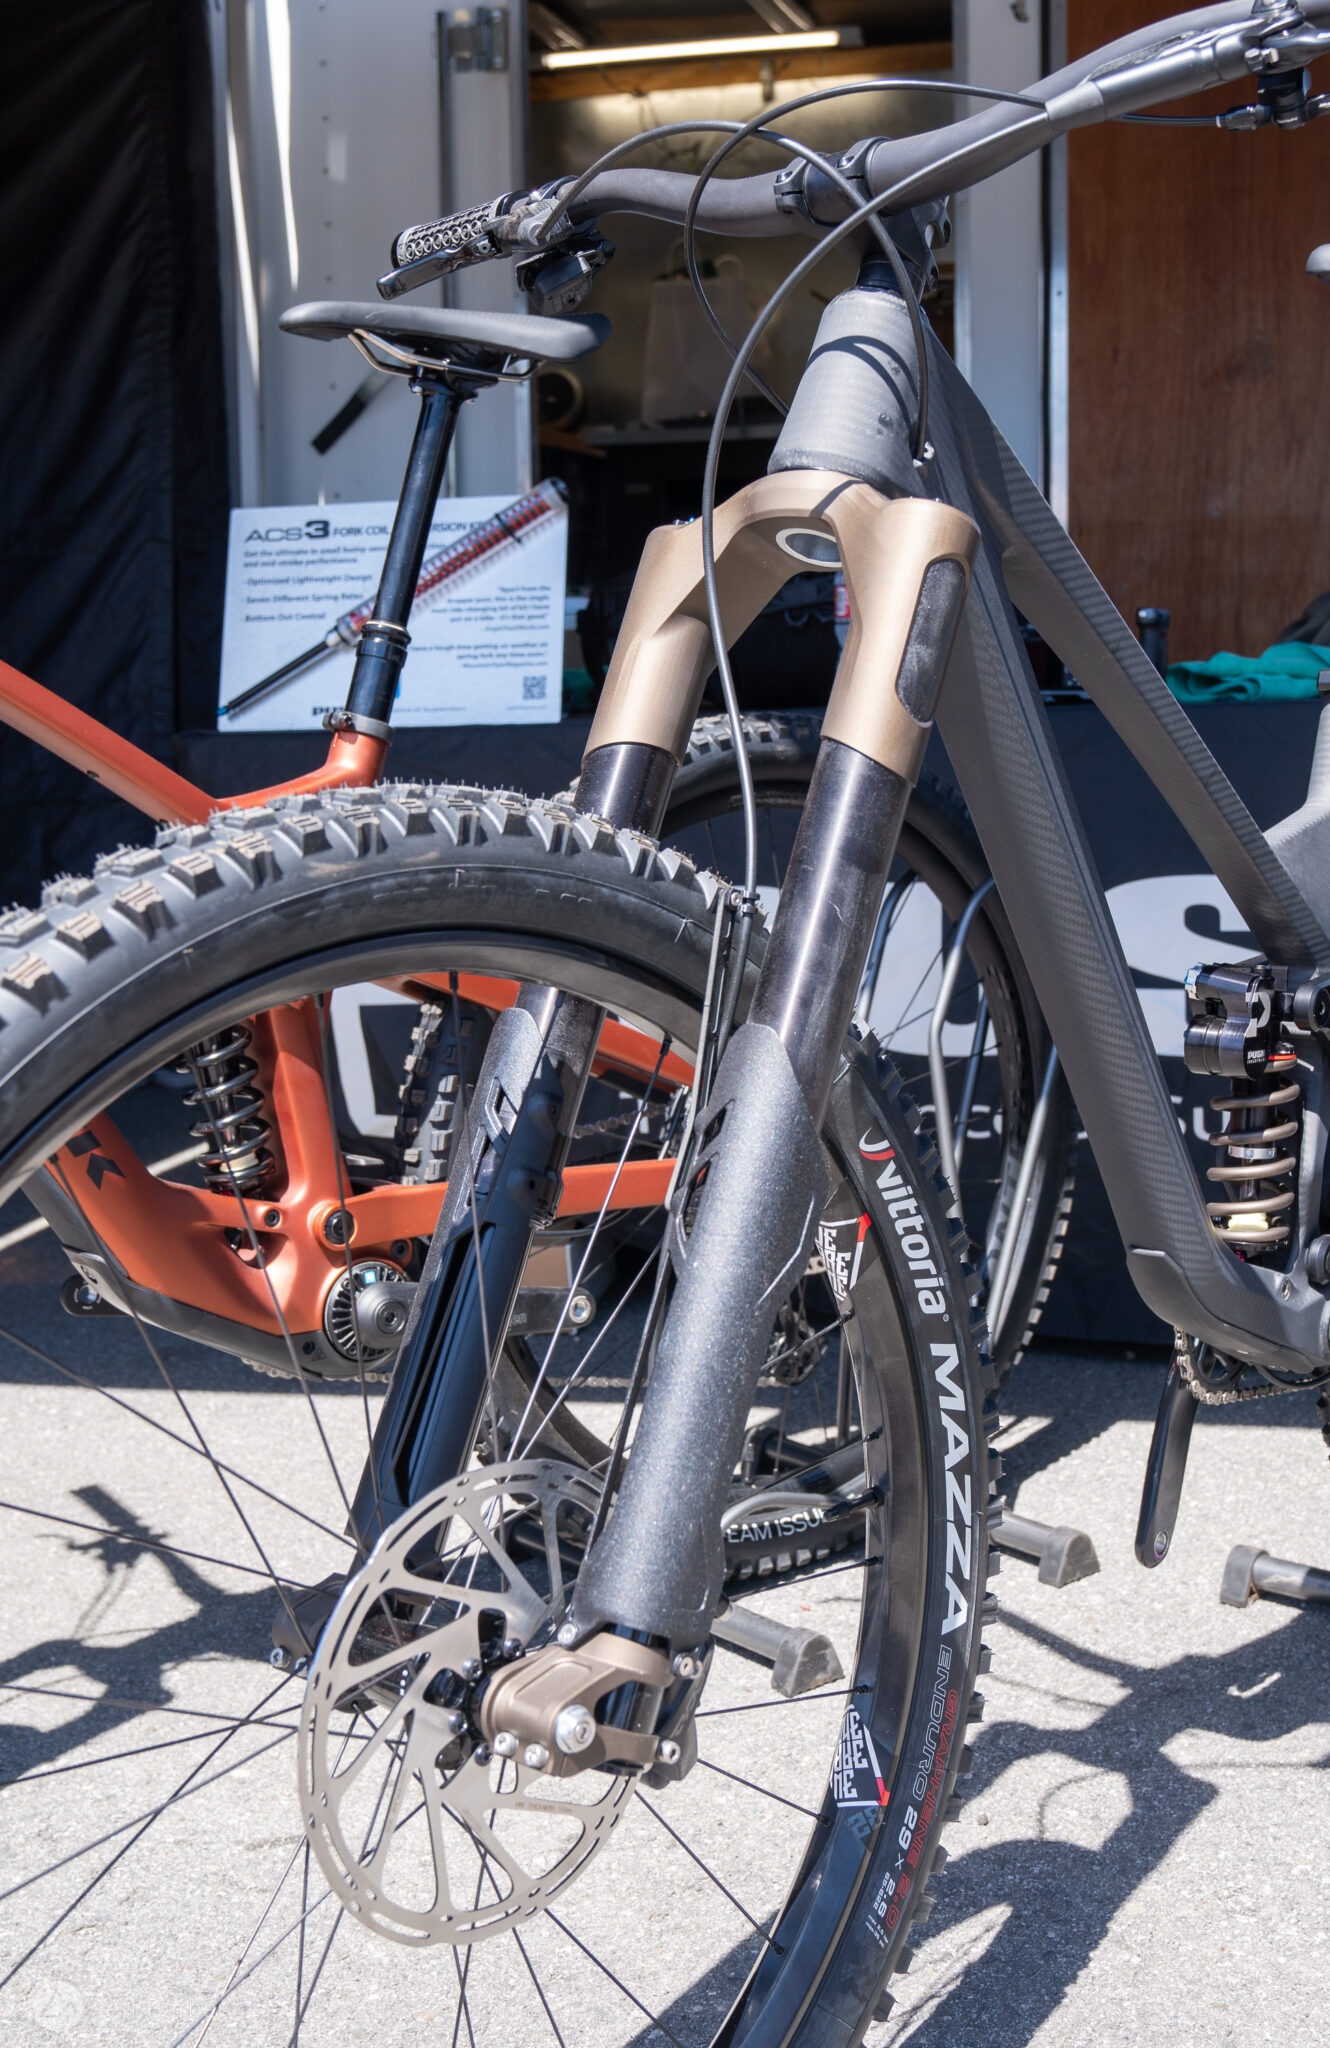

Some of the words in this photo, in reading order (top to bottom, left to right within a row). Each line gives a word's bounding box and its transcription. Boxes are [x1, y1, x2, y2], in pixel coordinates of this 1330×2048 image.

[244, 520, 330, 543] ACS3
[333, 527, 363, 537] FORK
[365, 525, 389, 536] COIL
[929, 1343, 972, 1636] MAZZA
[726, 1520, 773, 1544] EAM
[912, 1644, 953, 1801] ENDURO
[907, 1688, 959, 1869] GRAPHENE
[898, 1804, 919, 1851] 29
[877, 1877, 896, 1918] 2.6
